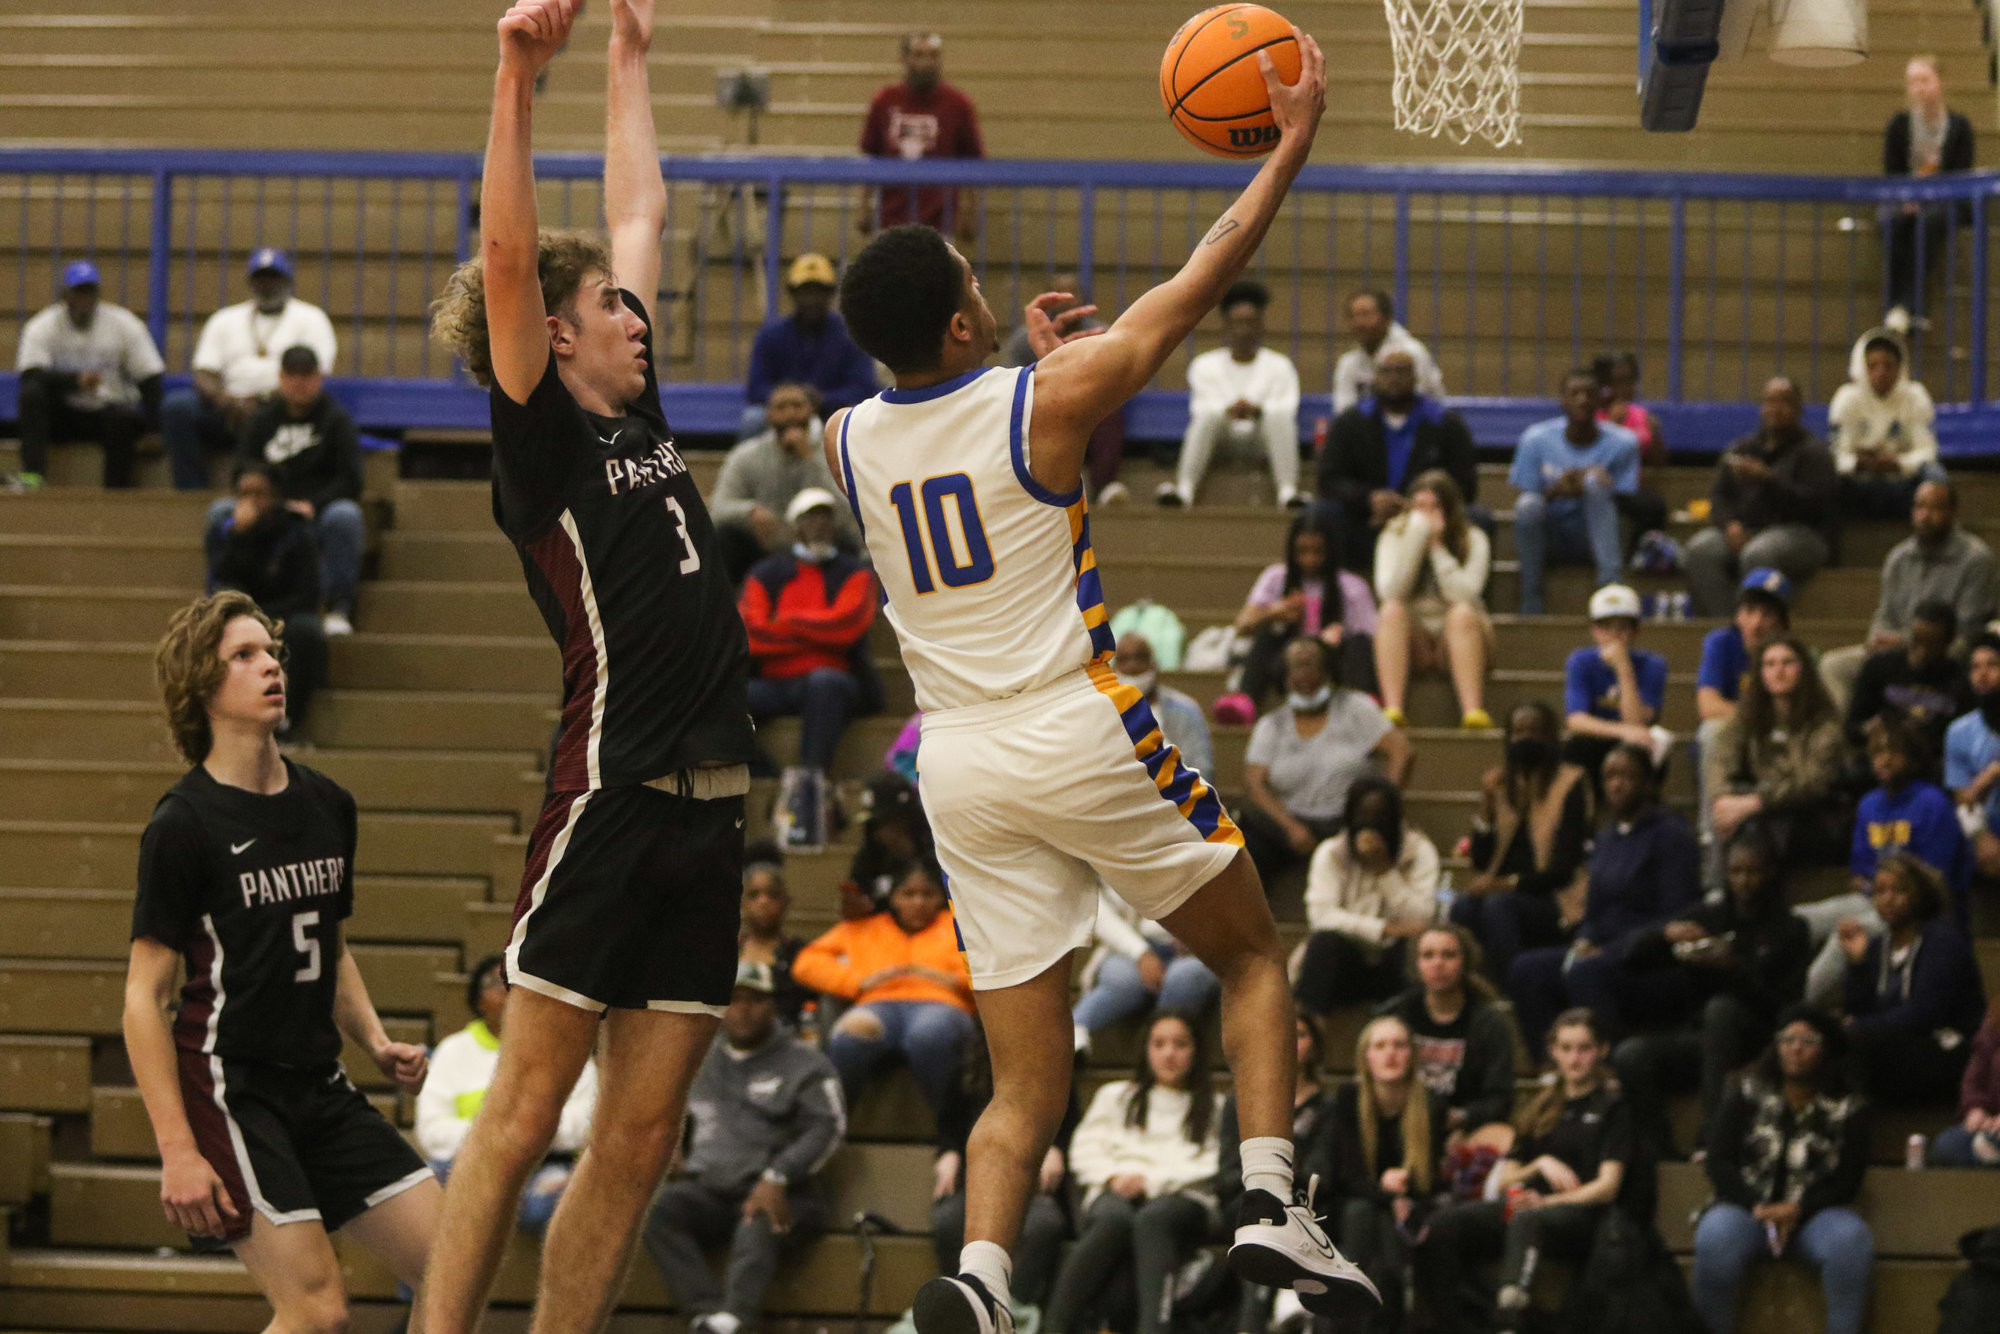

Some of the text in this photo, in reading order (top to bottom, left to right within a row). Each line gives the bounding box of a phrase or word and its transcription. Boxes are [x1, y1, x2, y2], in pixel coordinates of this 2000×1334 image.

[665, 496, 701, 575] 3
[888, 470, 998, 597] 10
[292, 910, 321, 983] 5
